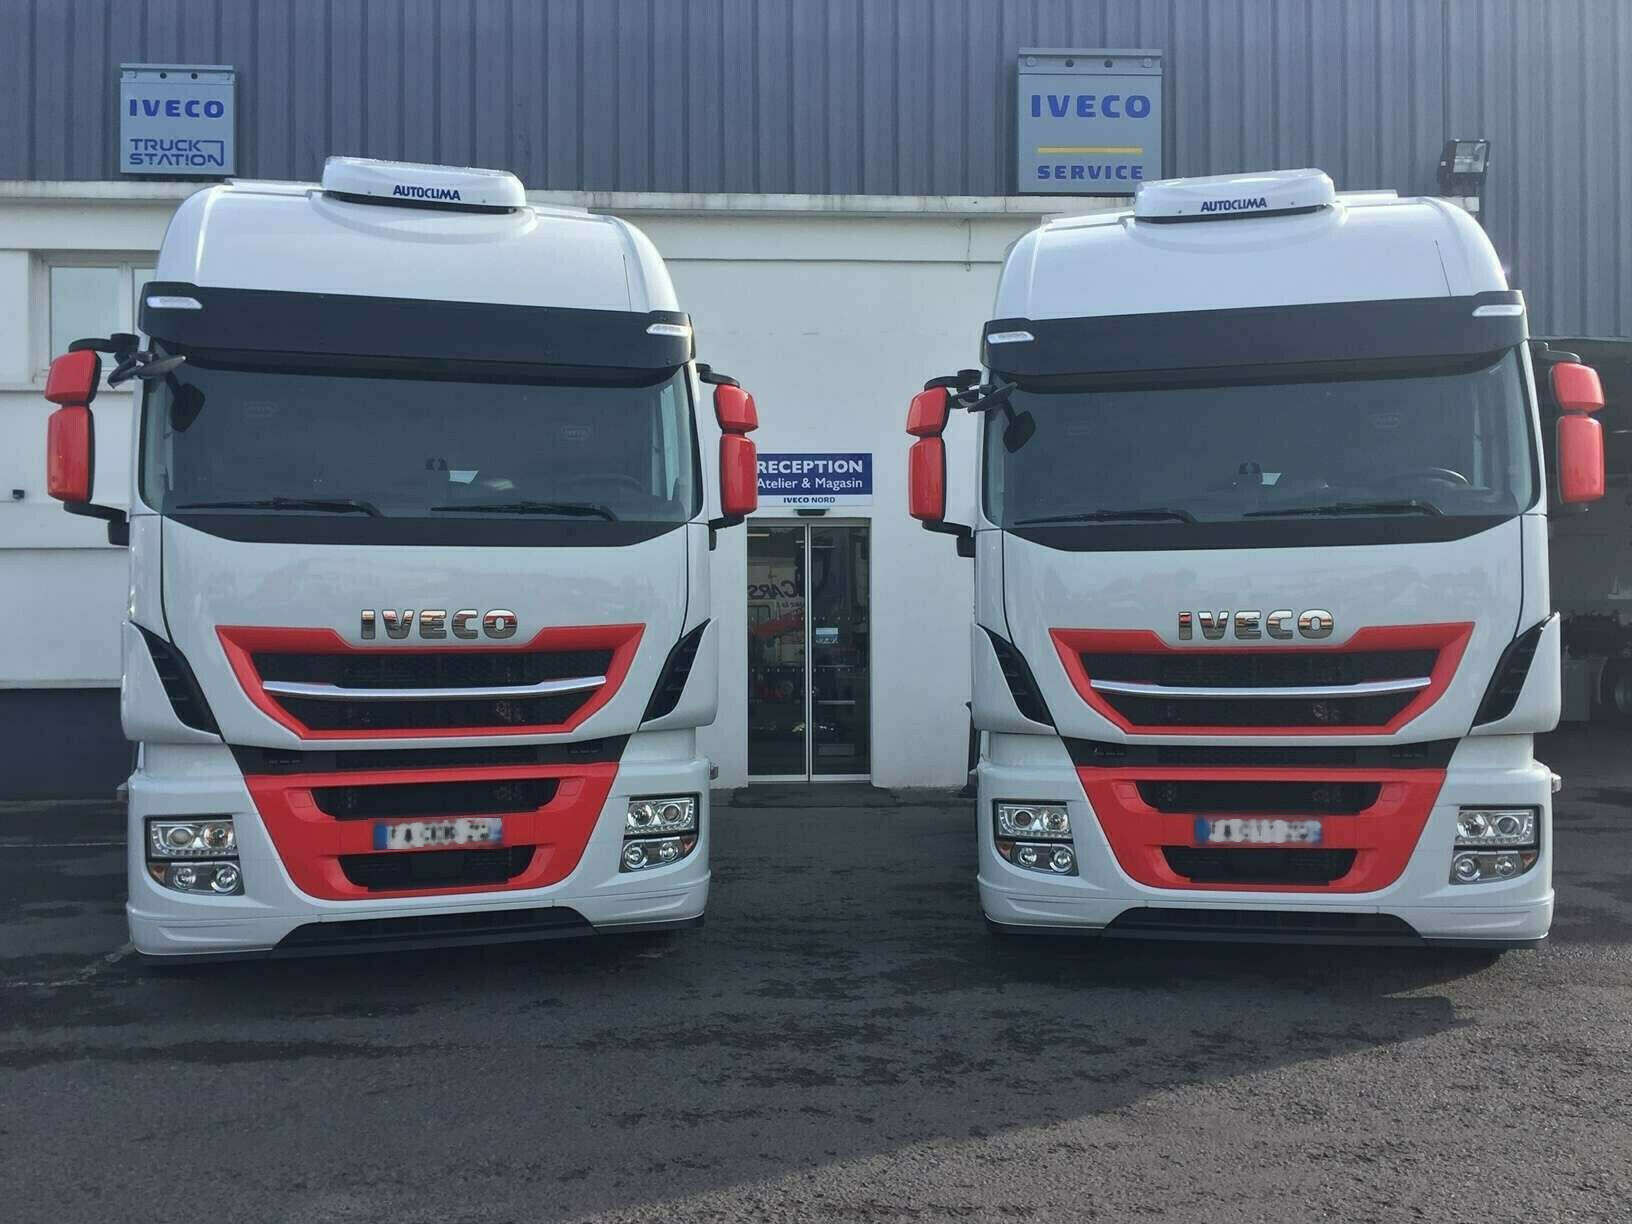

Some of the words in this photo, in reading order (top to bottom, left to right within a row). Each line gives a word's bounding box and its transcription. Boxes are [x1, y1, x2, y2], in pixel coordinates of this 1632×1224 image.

[129, 99, 224, 118] IVECO
[1031, 94, 1151, 118] IVECO
[130, 138, 202, 152] TRUCK
[129, 153, 224, 167] STATION
[1037, 165, 1144, 180] SERVICE
[393, 184, 461, 201] AUTOCLIMA
[1200, 197, 1267, 212] AUTOCLIMA
[757, 460, 863, 474] RECEPTION
[757, 478, 798, 489] Atelier
[801, 478, 811, 488] &
[815, 477, 863, 491] Magasin
[360, 609, 518, 640] IVECO
[1178, 609, 1334, 640] IVECO
